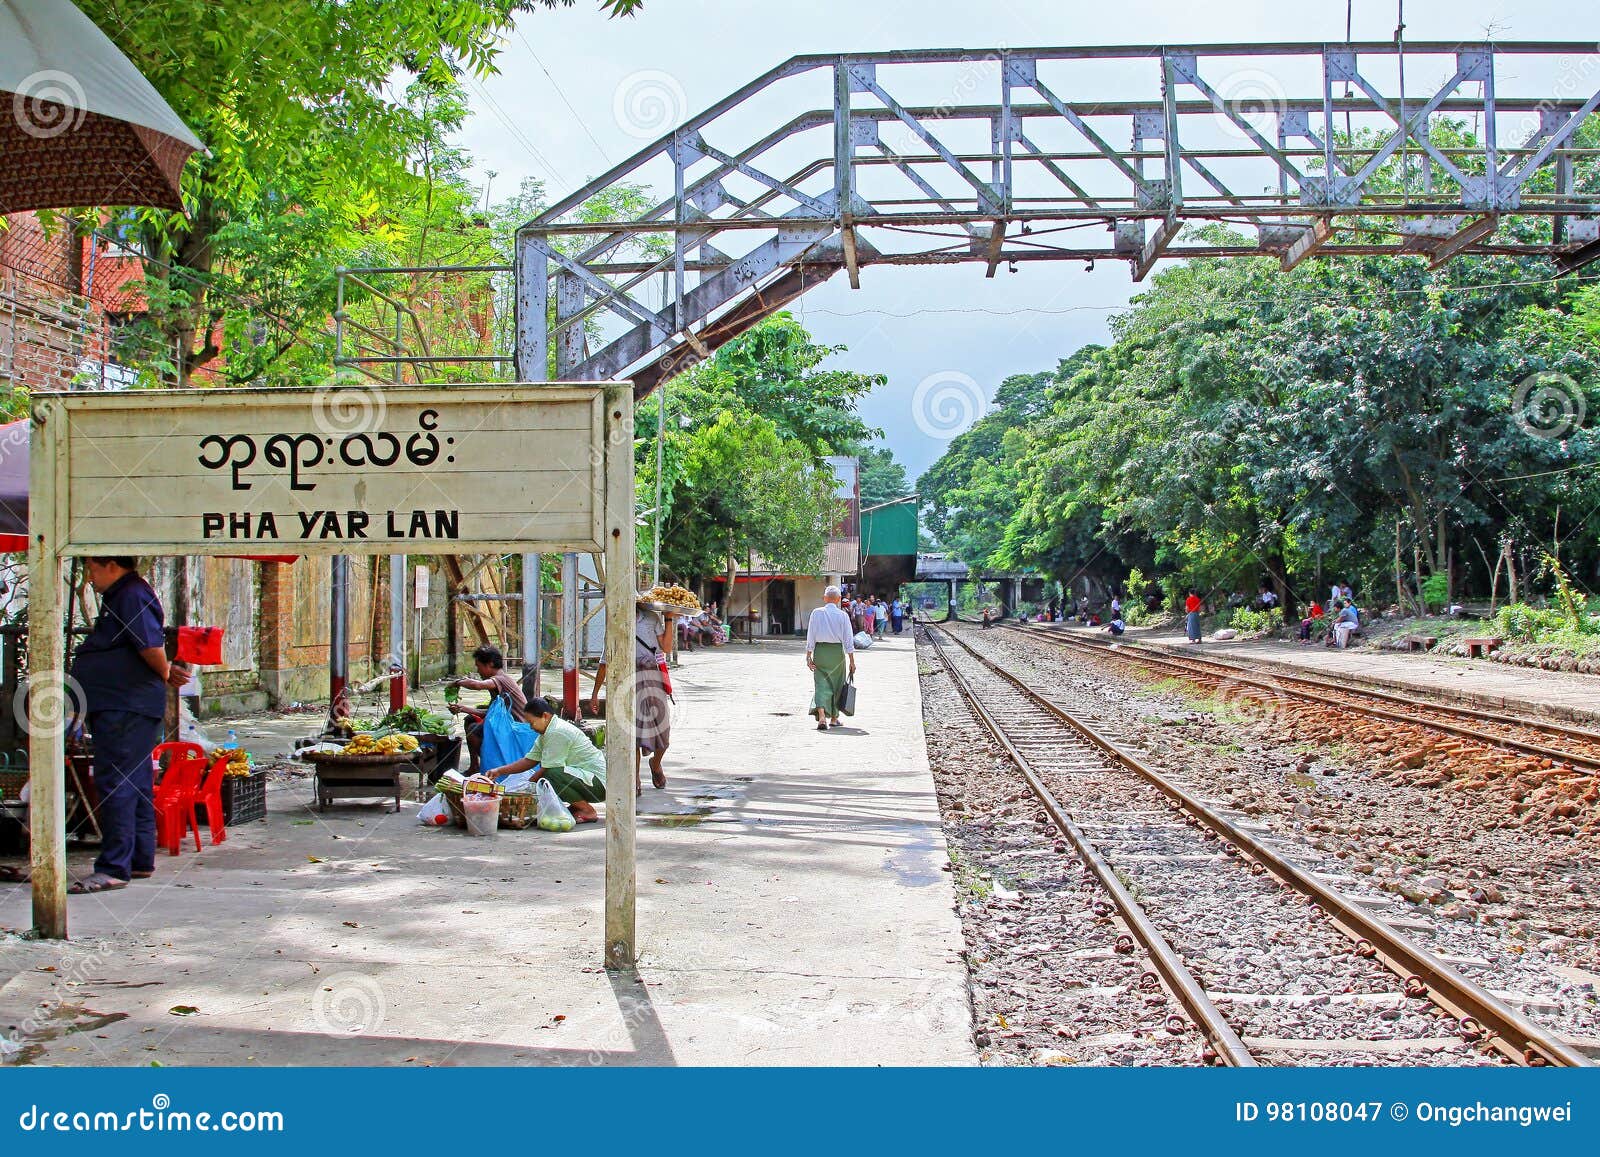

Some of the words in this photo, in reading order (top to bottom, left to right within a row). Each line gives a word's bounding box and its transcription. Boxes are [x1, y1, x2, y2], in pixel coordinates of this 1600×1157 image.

[198, 409, 456, 491] ဘုရားလမ်း
[202, 511, 279, 539] PHA
[297, 510, 370, 539] YAR
[386, 510, 459, 540] LAN
